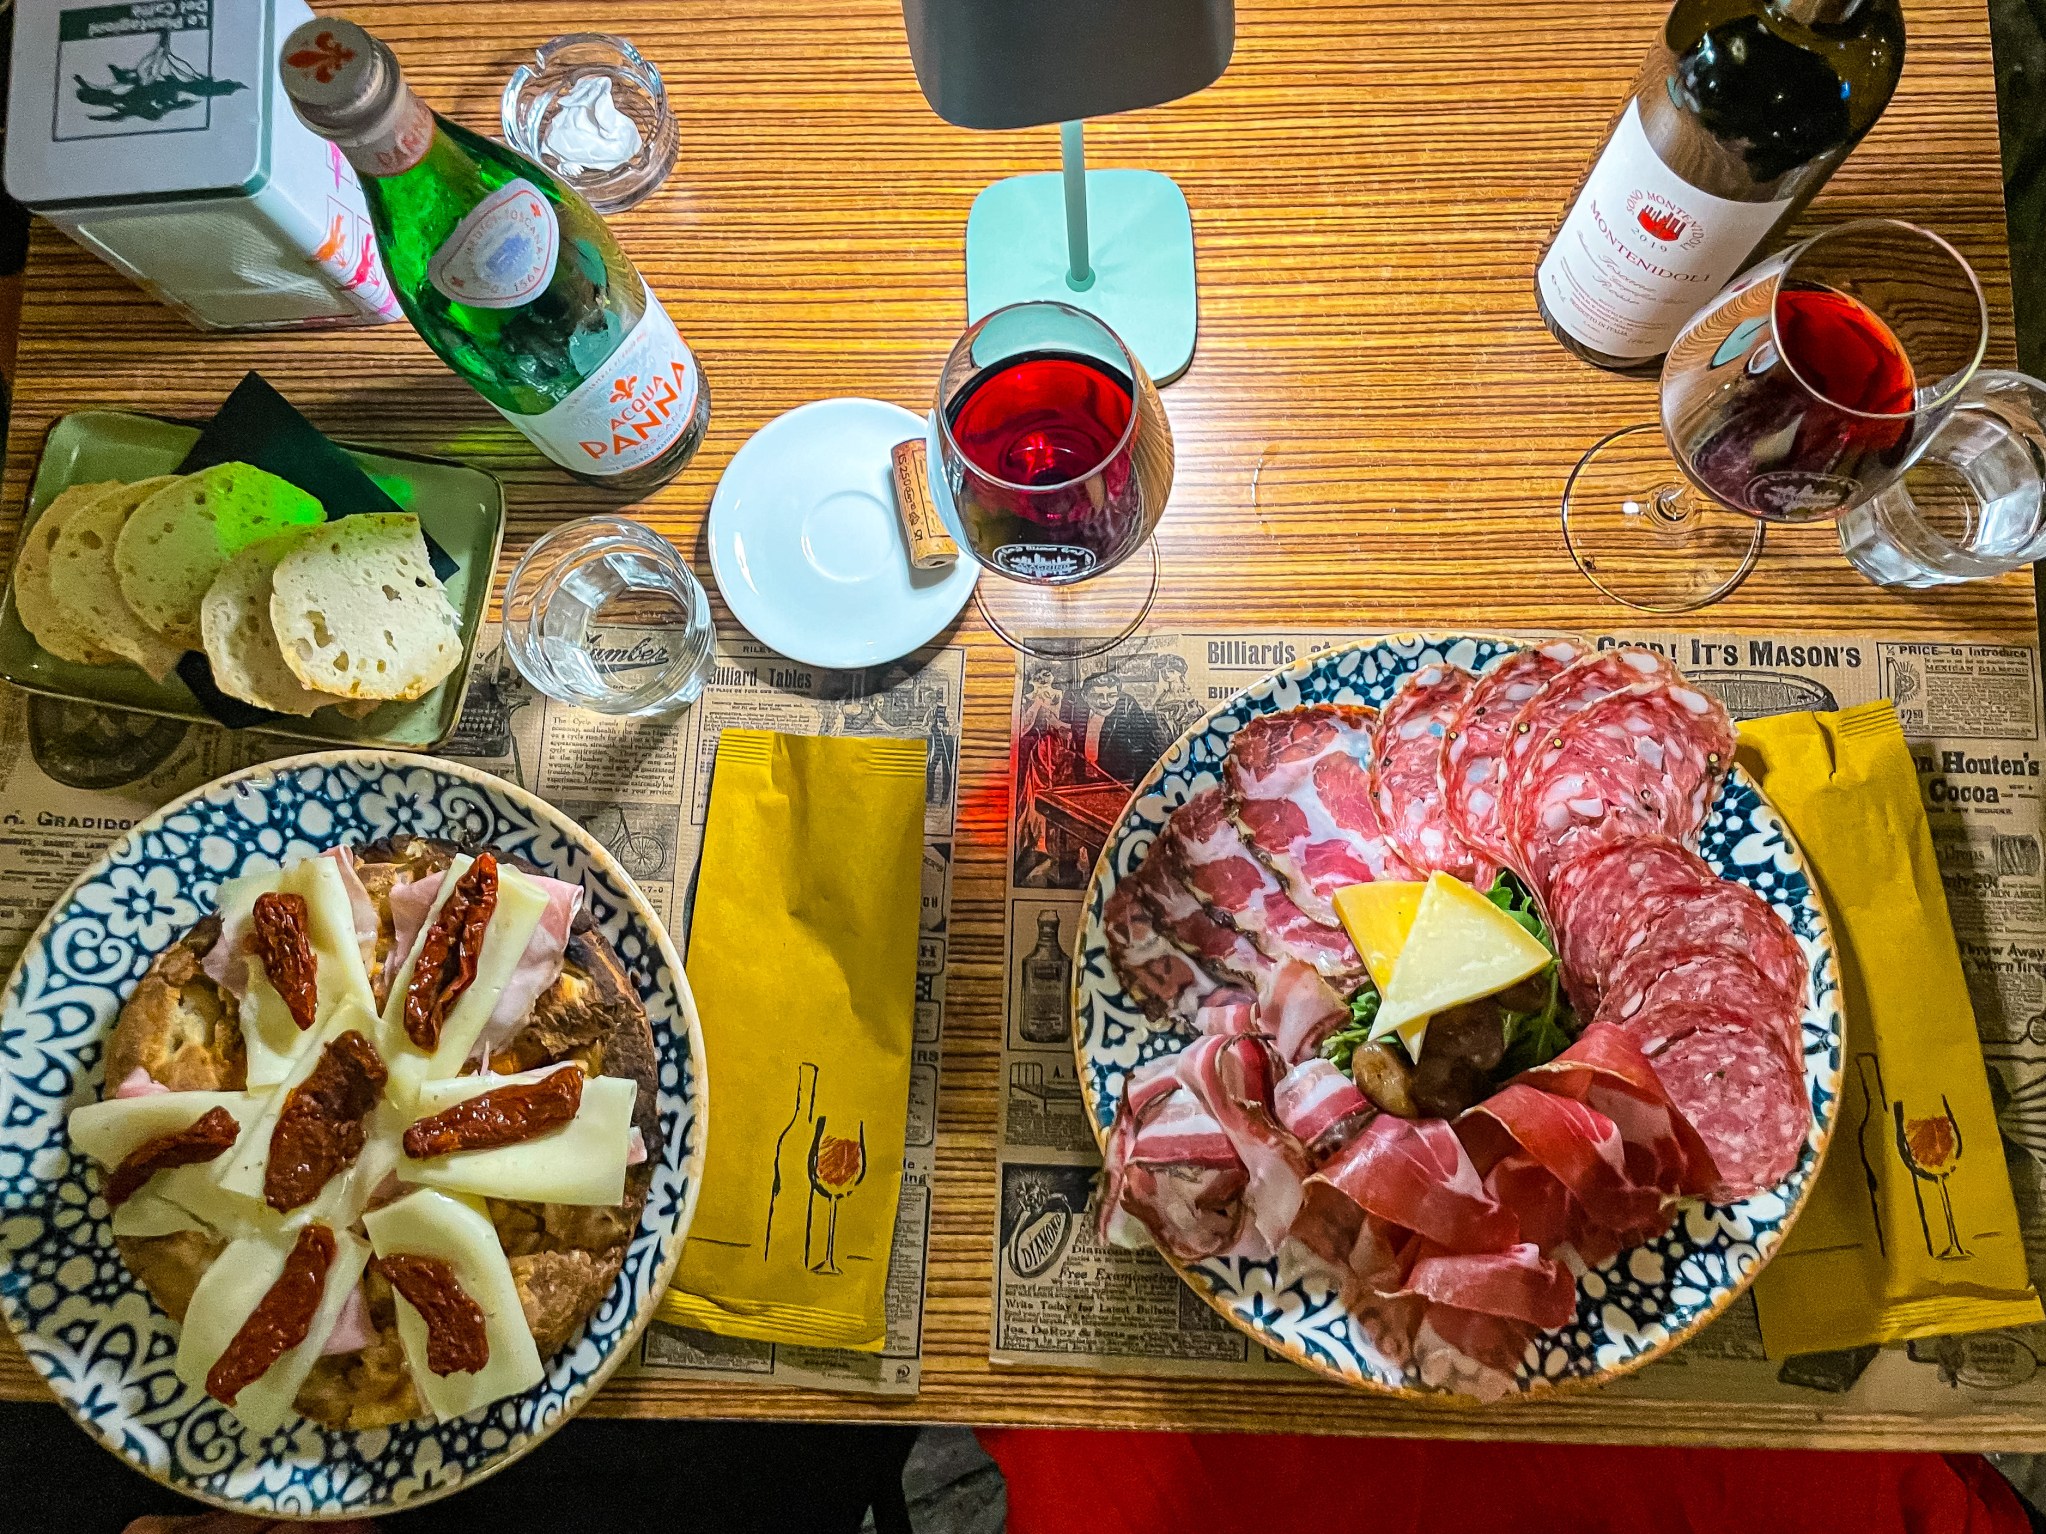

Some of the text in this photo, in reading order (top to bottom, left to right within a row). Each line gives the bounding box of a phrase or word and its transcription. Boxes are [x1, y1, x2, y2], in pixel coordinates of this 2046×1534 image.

[1625, 188, 1644, 215] SONO
[1589, 199, 1712, 303] MONTENIDOLI
[1630, 226, 1668, 253] 2019
[578, 361, 686, 460] PANNA
[609, 374, 665, 433] ACQUA
[1207, 640, 1296, 665] Billiards
[1691, 638, 1739, 667] IT'S
[1749, 640, 1862, 668] MASON'S
[768, 667, 812, 689] Tables
[1940, 750, 2040, 777] Houten's
[1928, 777, 2000, 804] Cocoa
[1021, 1213, 1062, 1269] DIAMOND
